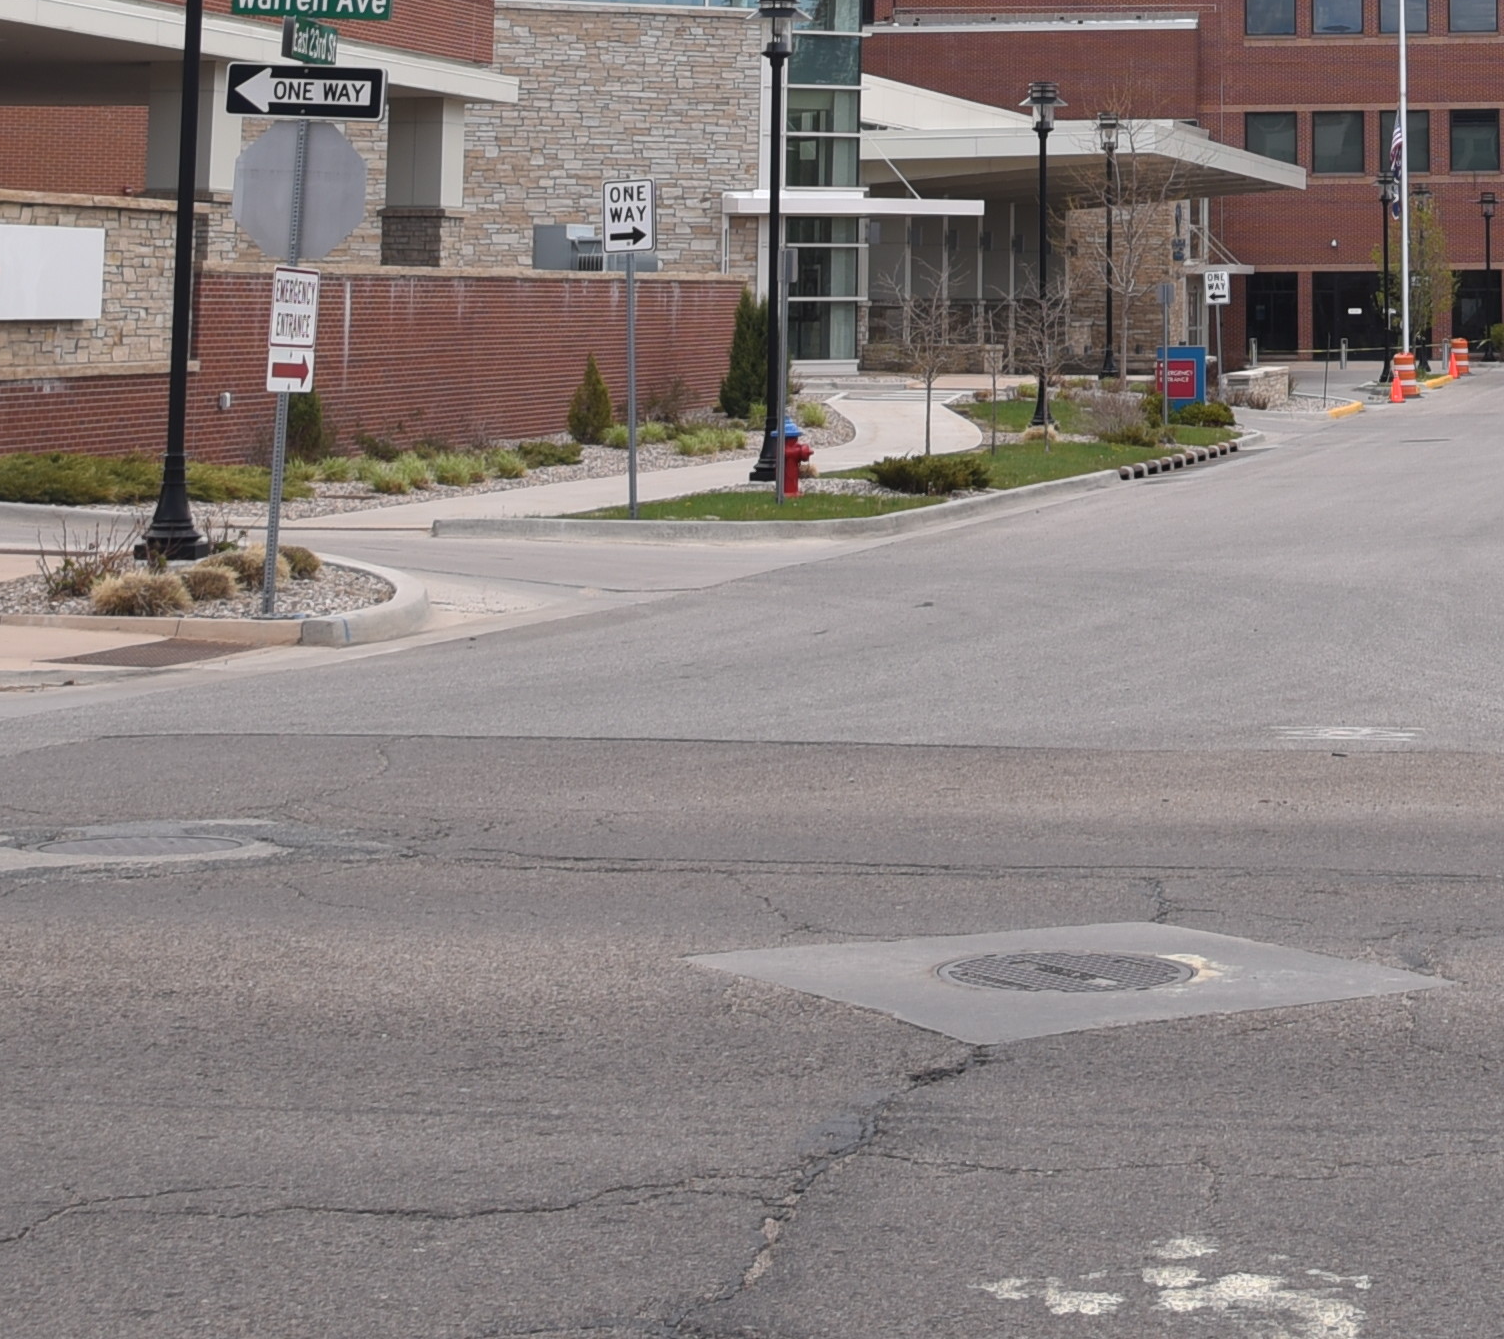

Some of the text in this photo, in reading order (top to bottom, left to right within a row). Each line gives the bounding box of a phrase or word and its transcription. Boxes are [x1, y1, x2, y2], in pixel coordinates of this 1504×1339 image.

[293, 22, 337, 62] East 23rd St
[274, 81, 365, 103] ONE WAY
[610, 185, 647, 203] ONE
[610, 205, 647, 223] WAY
[1207, 273, 1225, 282] ONE
[1207, 283, 1226, 291] WAY
[276, 278, 316, 305] EMERGENCY
[276, 312, 311, 338] ENTRANCE
